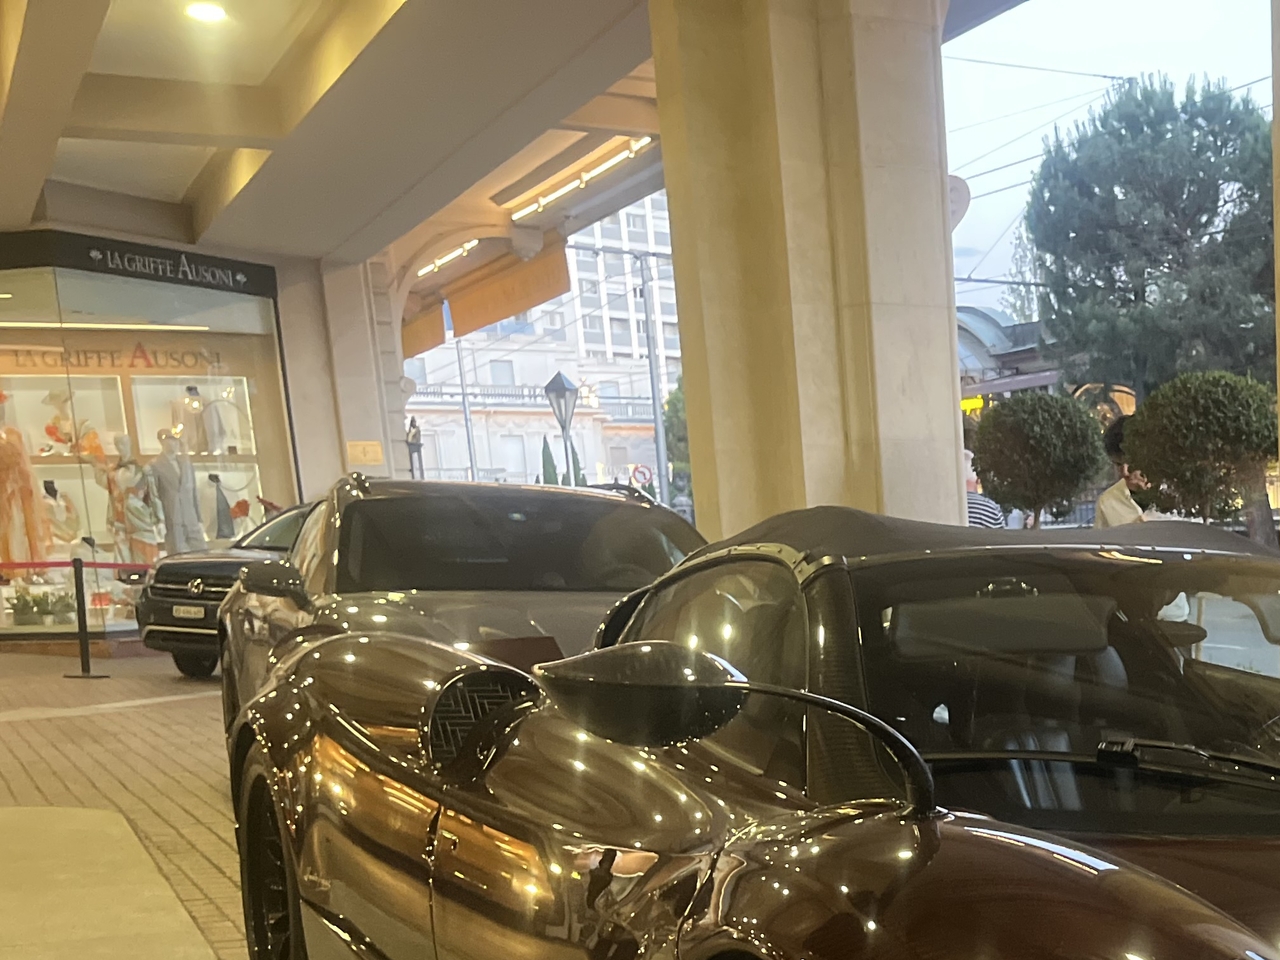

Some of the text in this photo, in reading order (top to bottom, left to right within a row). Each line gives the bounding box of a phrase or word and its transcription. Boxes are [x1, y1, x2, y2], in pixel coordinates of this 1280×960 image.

[107, 251, 233, 286] LA GRIFFE AUSONI
[15, 341, 220, 369] LA GRIFFE AUSONI
